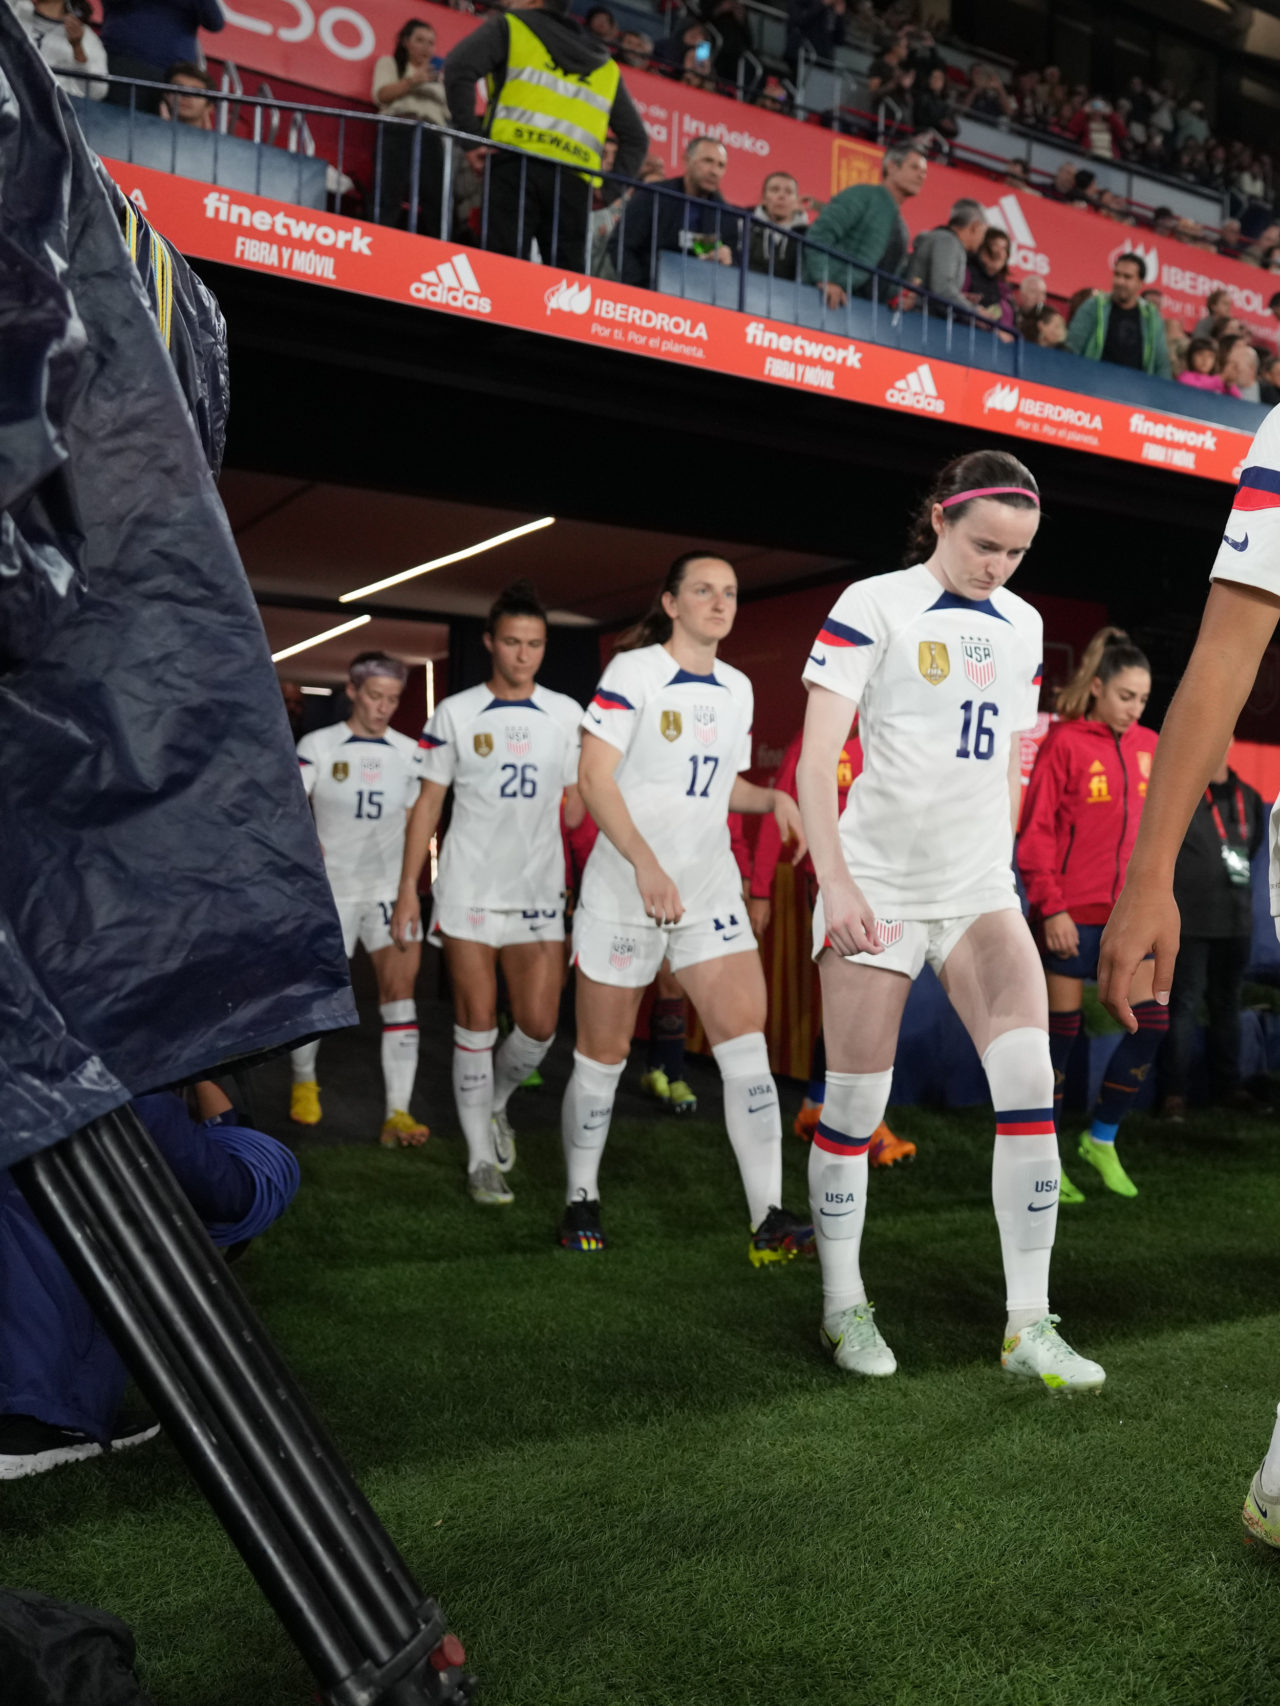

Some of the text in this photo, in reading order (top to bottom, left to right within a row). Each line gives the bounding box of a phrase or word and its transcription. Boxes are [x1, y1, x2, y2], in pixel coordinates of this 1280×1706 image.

[511, 126, 591, 164] STEWARD
[203, 190, 373, 256] finetwork
[235, 235, 337, 280] FIBRA Y MÓVIL
[409, 280, 492, 314] adidas
[594, 297, 708, 341] IBERDROLA
[591, 322, 706, 359] Por ti. Por el planeta.
[745, 321, 862, 369] finetwork
[764, 356, 795, 381] FIBRA
[797, 364, 805, 383] Y
[885, 387, 945, 414] adidas
[1018, 397, 1103, 431] IBERDROLA
[1129, 413, 1217, 451] finetwork
[965, 645, 991, 663] USA
[956, 700, 999, 761] 16
[500, 762, 538, 798] 26
[686, 754, 719, 798] 17
[355, 789, 384, 820] 15
[748, 1084, 773, 1097] USA
[825, 1191, 855, 1204] USA
